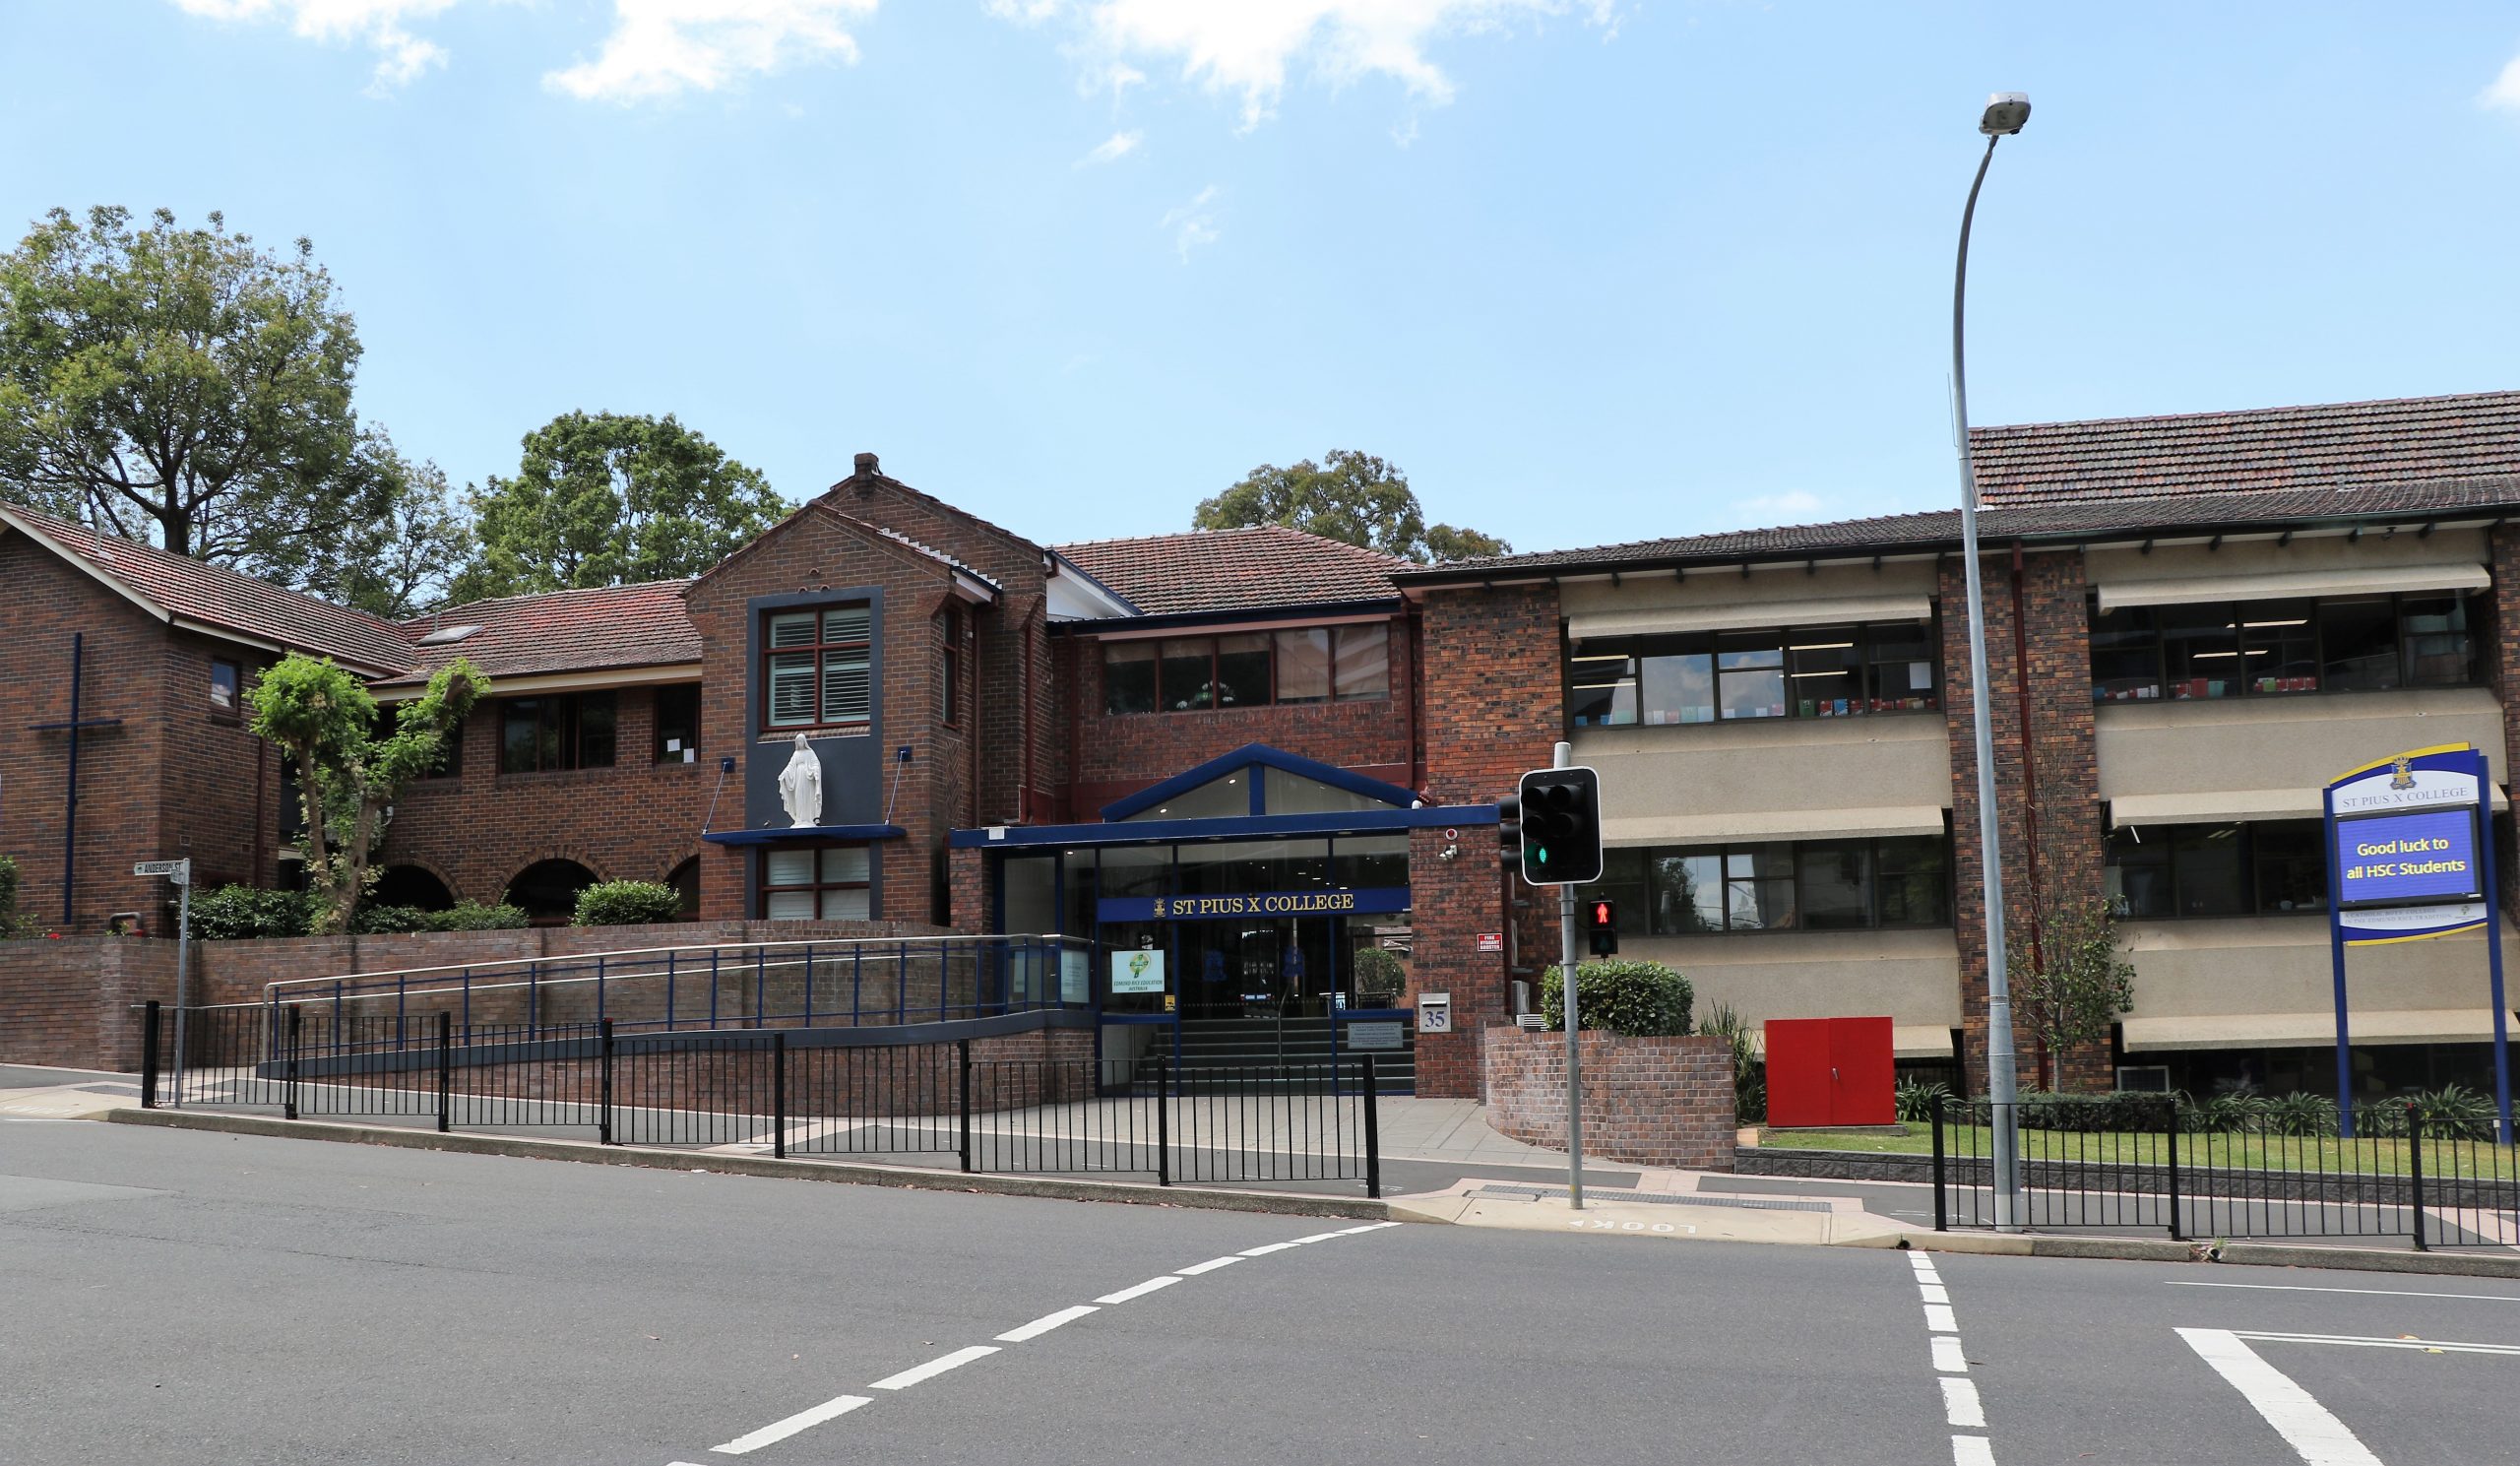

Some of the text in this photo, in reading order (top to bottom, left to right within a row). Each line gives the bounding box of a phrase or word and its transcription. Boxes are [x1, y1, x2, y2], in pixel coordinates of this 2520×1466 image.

[2343, 788, 2469, 808] ST PIUS X COLLEGE
[2357, 838, 2449, 857] Good luck to
[2347, 860, 2466, 880] all HSC Students
[1172, 893, 1354, 916] ST PIUS X COLLEGE
[1424, 1010, 1445, 1028] 35
[1591, 1220, 1696, 1234] LOOK
